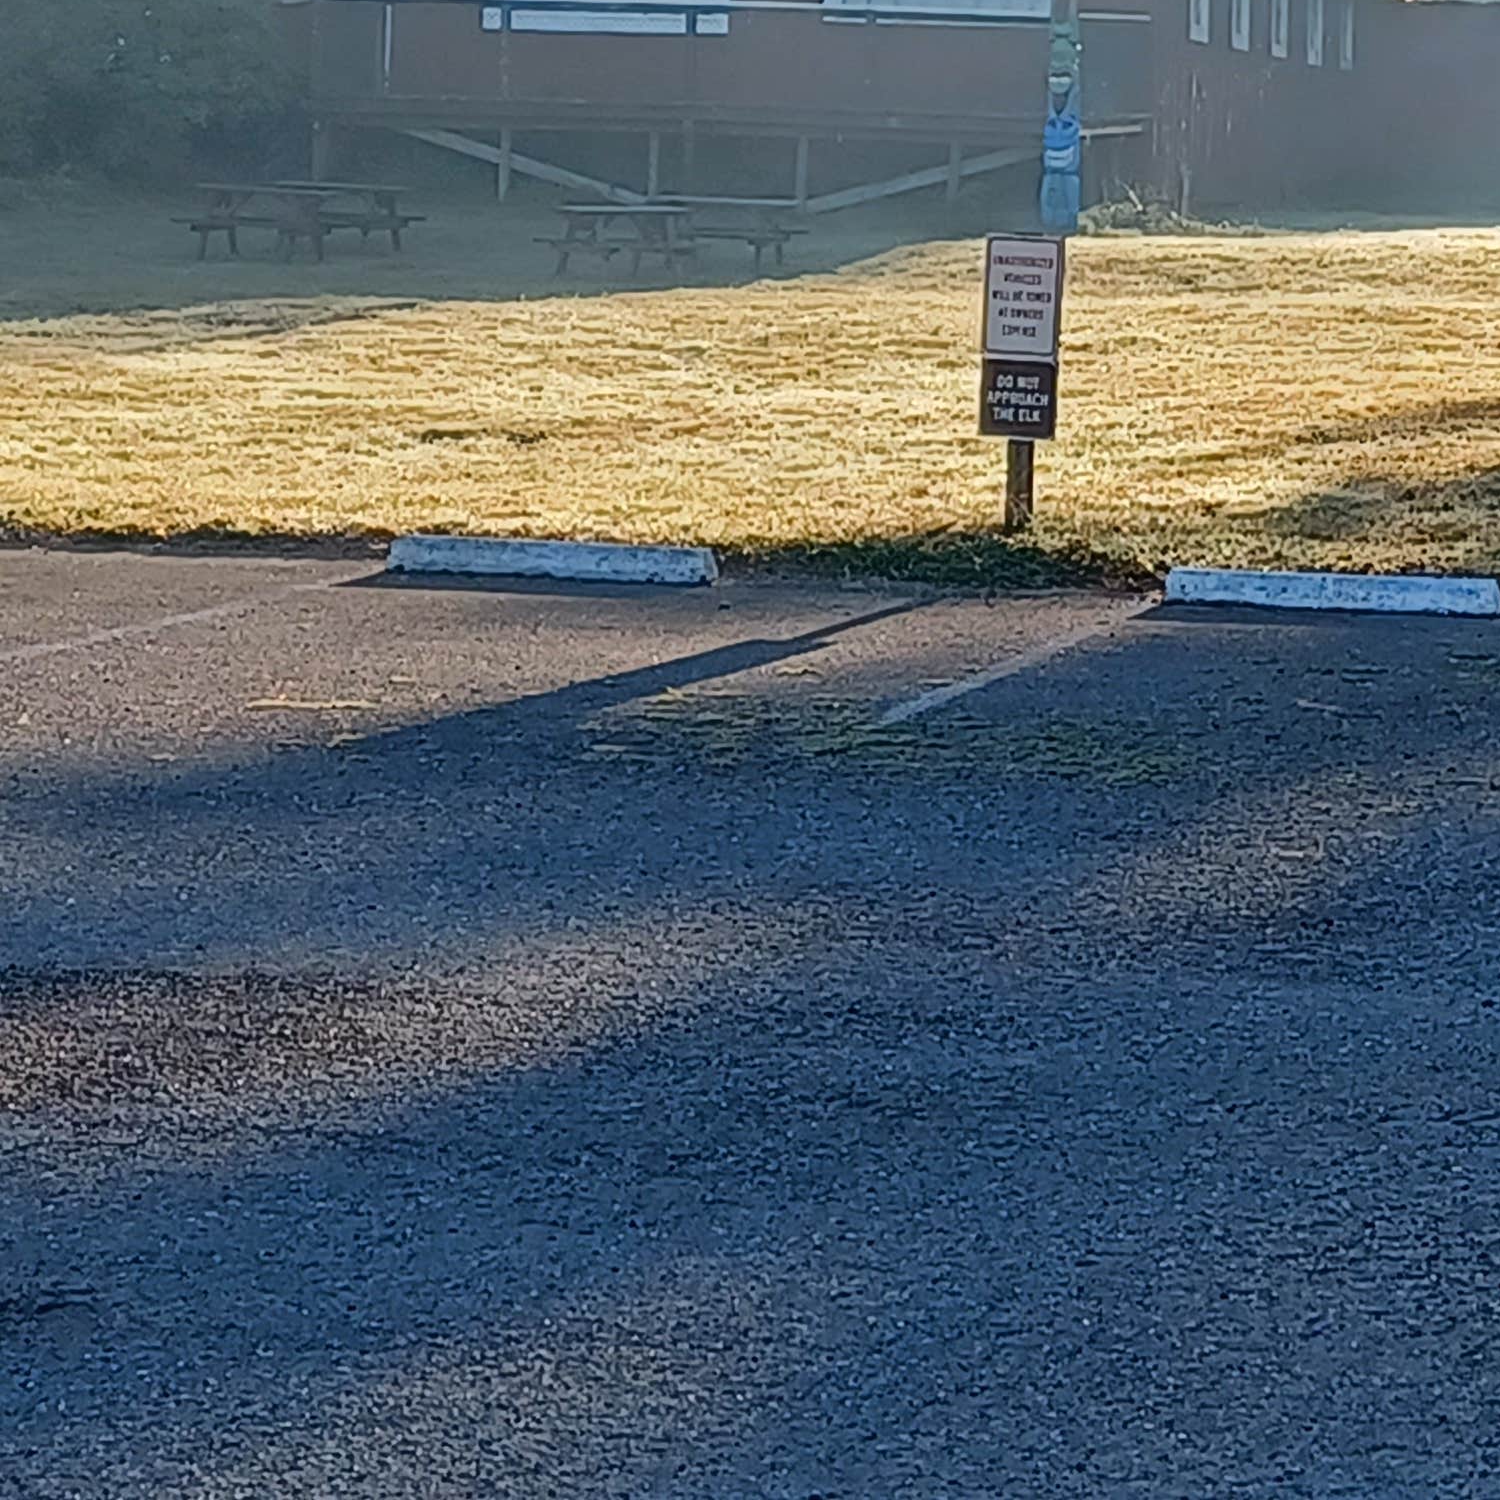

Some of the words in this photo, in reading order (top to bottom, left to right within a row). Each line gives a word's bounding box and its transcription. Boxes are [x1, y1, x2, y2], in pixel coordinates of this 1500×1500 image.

[996, 374, 1013, 388] DO
[1017, 376, 1040, 390] NOT
[987, 390, 1049, 406] APPROACH
[992, 406, 1015, 422] THE
[1018, 408, 1041, 422] ELK
